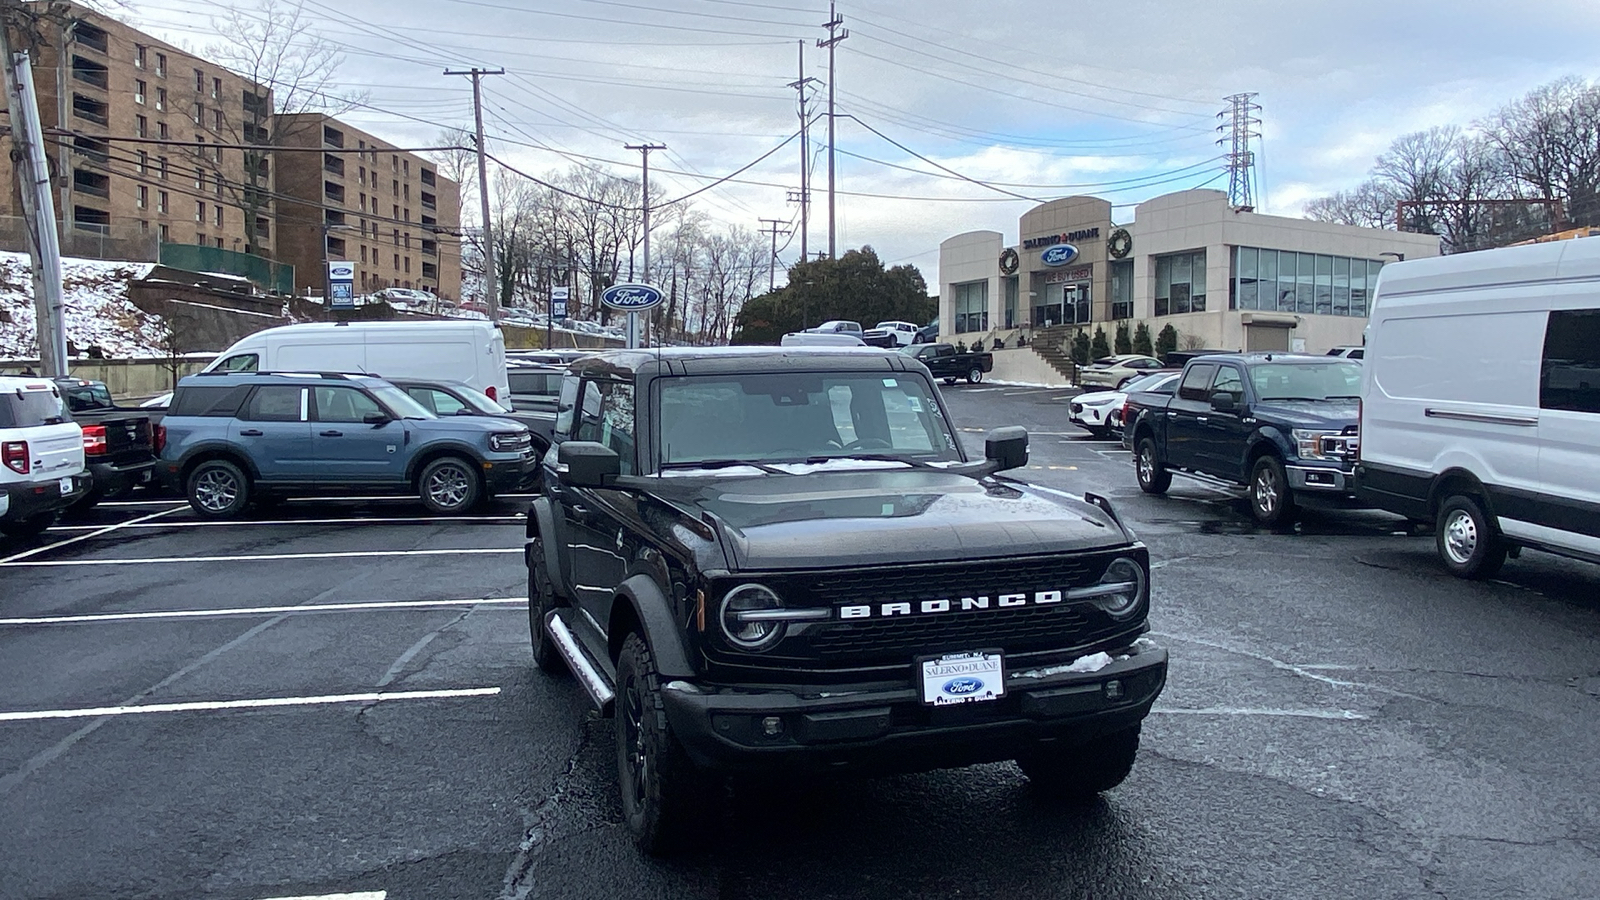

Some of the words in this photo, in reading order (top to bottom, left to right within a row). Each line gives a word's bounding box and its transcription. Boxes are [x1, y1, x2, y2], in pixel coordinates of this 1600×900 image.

[1023, 235, 1061, 250] SALERNO
[1068, 227, 1100, 242] DUANE
[1046, 248, 1068, 263] Ford
[1071, 268, 1090, 280] USED
[612, 288, 650, 305] Ford
[840, 590, 1063, 619] BRONCO
[925, 662, 966, 676] SALERNO
[968, 660, 1000, 672] DUANE
[949, 680, 977, 693] Ford
